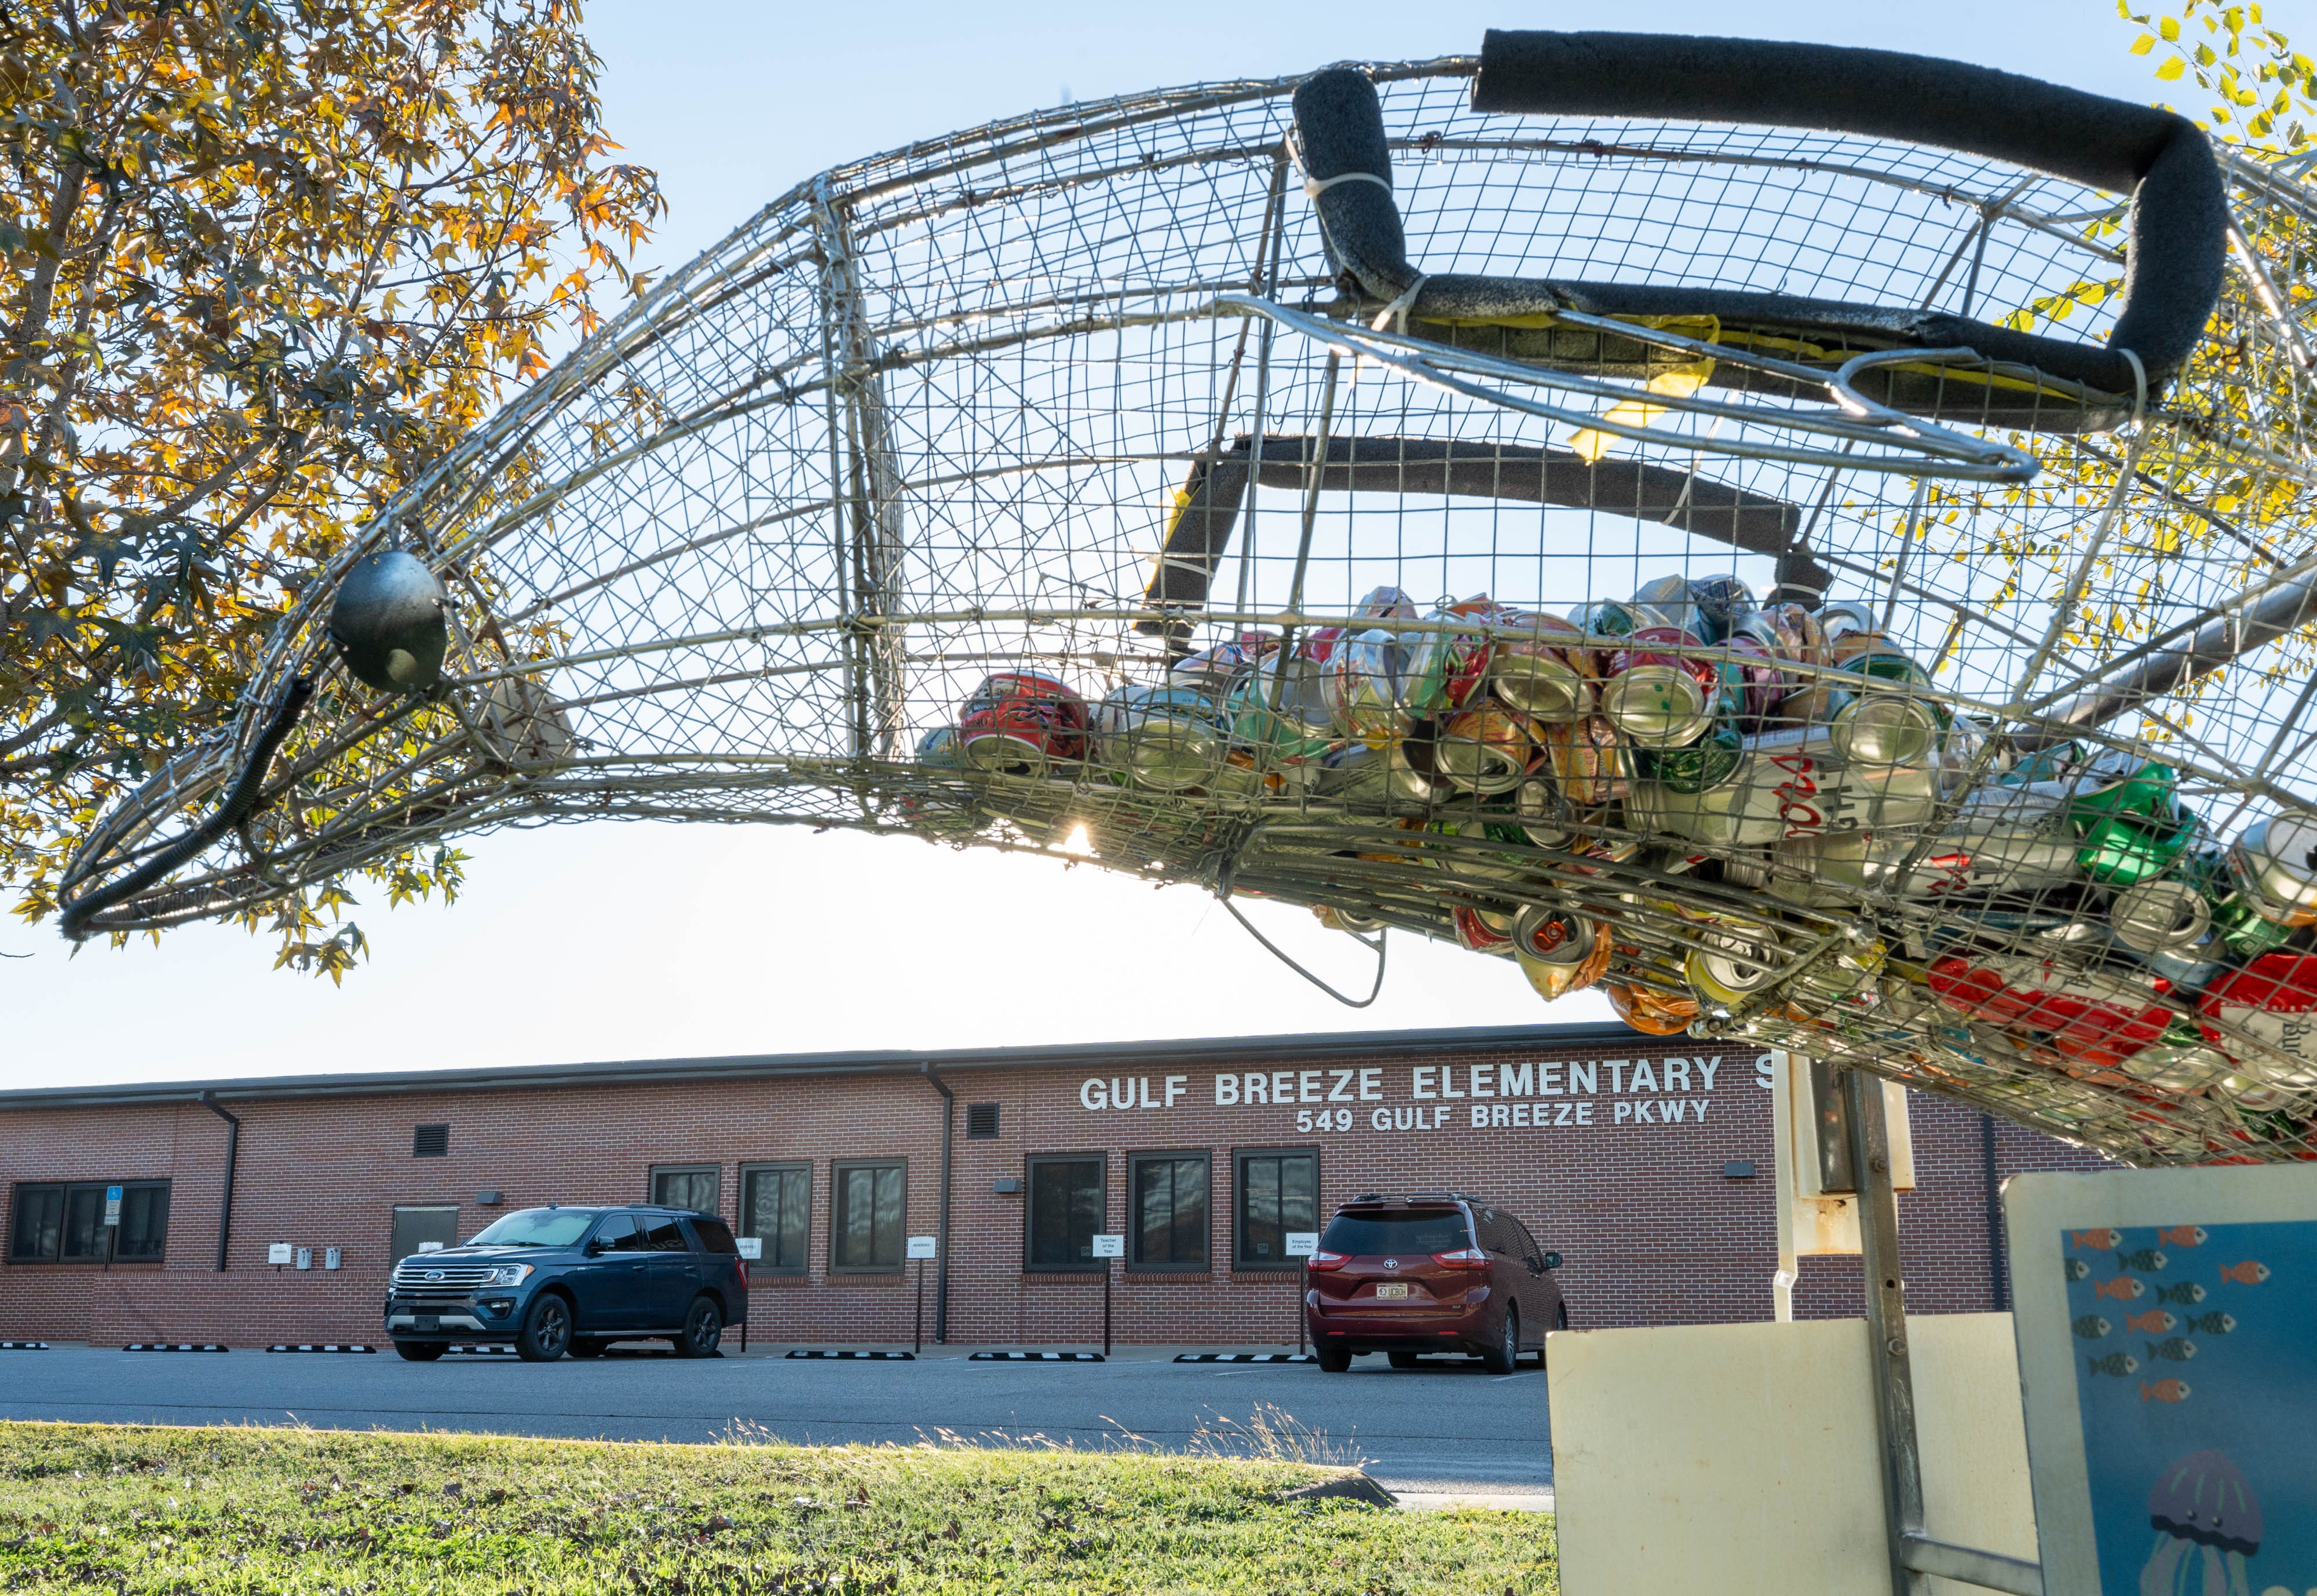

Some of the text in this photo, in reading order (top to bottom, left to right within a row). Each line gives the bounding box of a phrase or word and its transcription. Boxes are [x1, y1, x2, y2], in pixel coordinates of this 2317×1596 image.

[1080, 1075, 1187, 1110] GULF
[1215, 1067, 1383, 1106] BREEZE
[1412, 1056, 1722, 1099] ELEMENTARY
[1296, 1099, 1710, 1133] 549 GULF BREEZE PKWY
